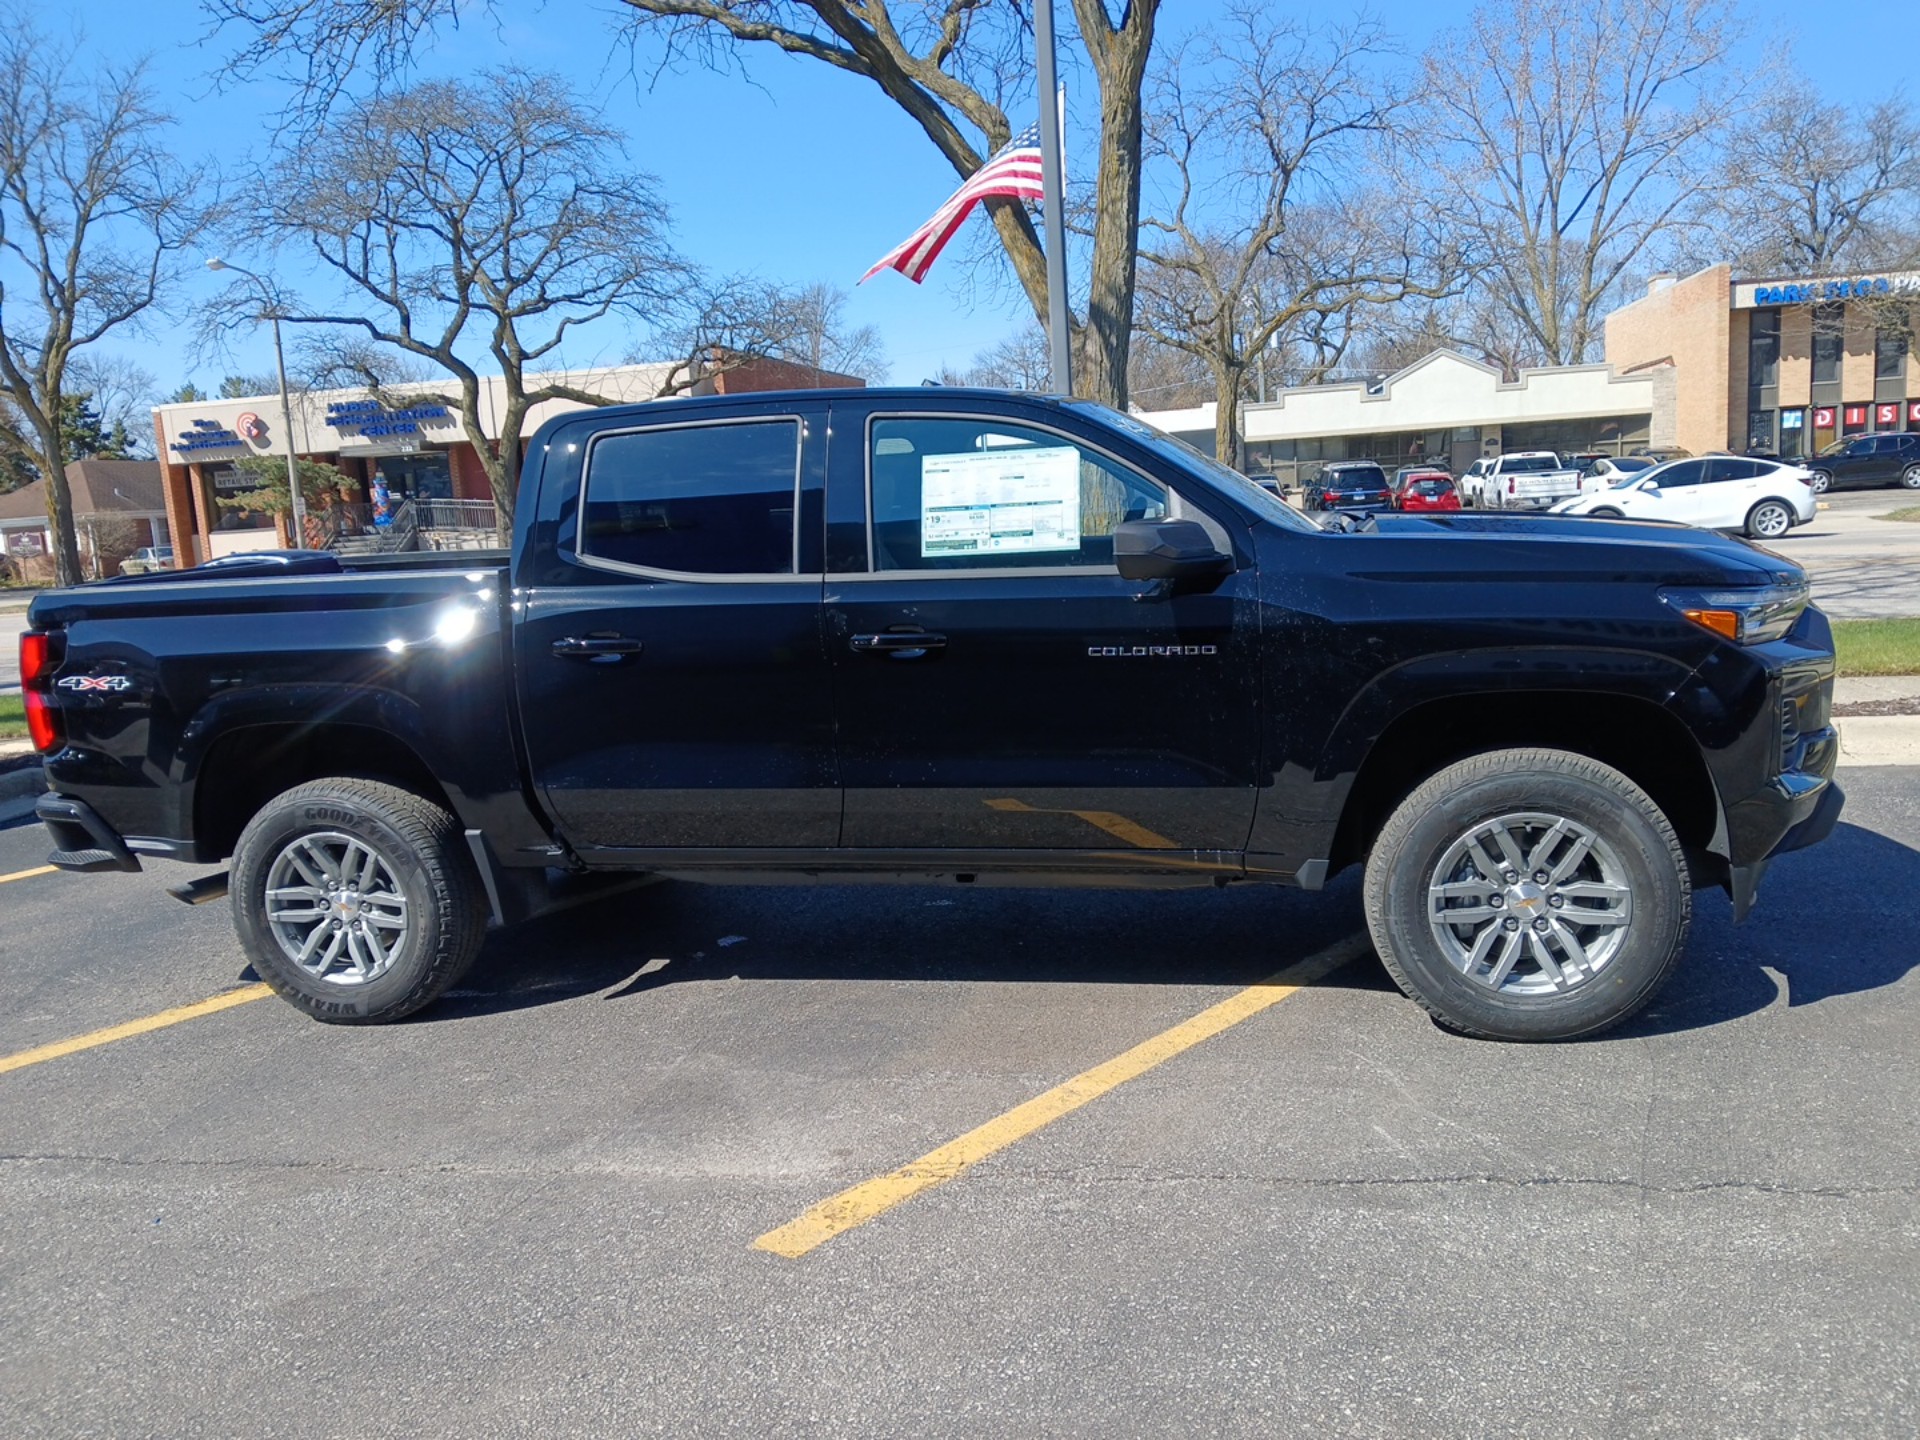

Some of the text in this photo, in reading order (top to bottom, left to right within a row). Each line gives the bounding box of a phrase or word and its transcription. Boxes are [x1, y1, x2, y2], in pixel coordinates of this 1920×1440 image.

[327, 399, 378, 413] HUBER
[360, 422, 417, 437] CENTER
[1088, 645, 1217, 657] COLORADO
